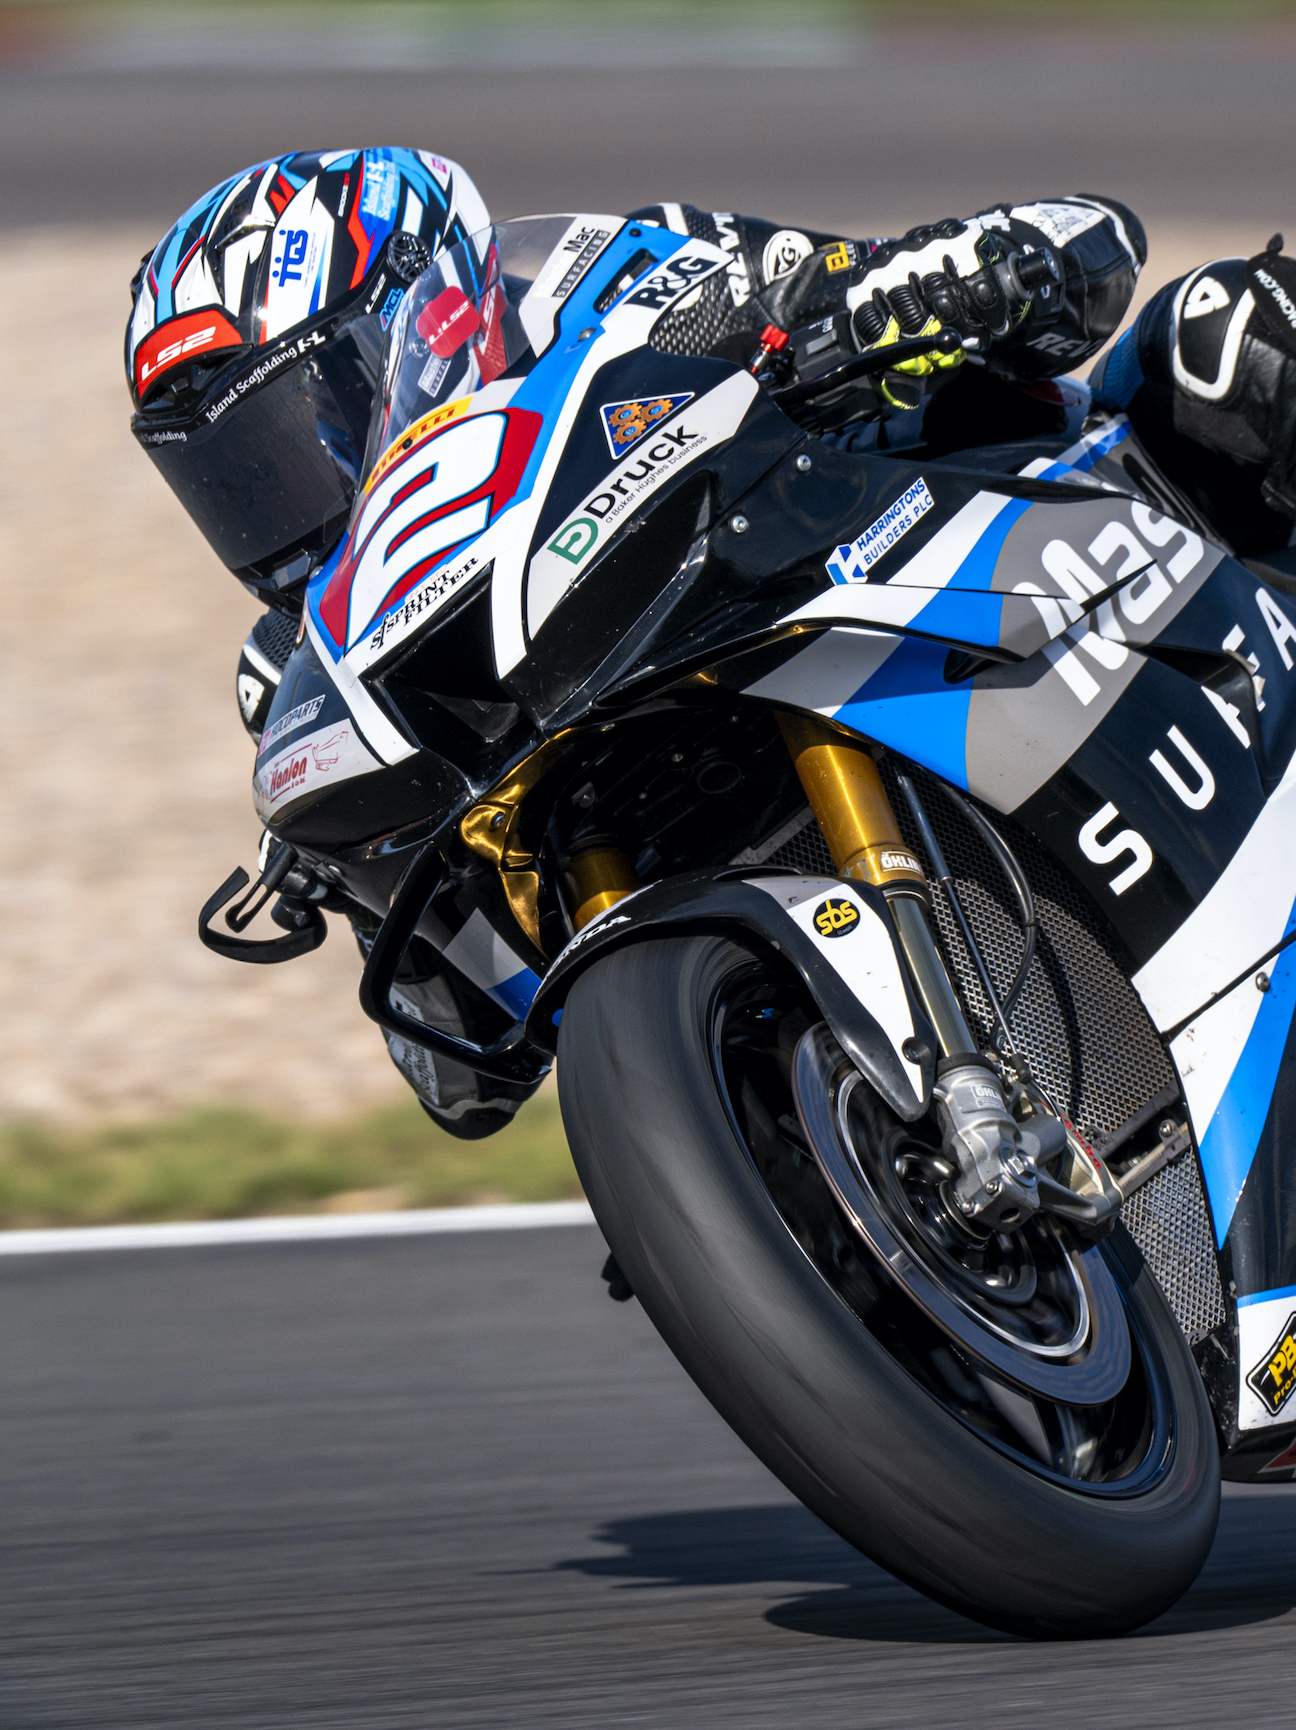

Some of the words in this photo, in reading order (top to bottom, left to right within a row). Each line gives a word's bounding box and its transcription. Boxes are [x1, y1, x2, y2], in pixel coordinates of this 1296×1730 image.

[273, 229, 309, 287] TGS
[555, 230, 610, 298] SURFACING
[624, 254, 719, 311] R&G
[364, 272, 387, 314] LS2
[141, 326, 217, 381] LS2
[205, 390, 238, 423] Island
[236, 346, 297, 394] Scaffolding
[583, 424, 700, 520] Druck
[605, 514, 613, 524] a
[612, 491, 637, 521] Baker
[634, 464, 670, 497] Hughes
[668, 434, 708, 469] business
[856, 479, 926, 552] HARRINGTONS
[863, 514, 913, 566] BUILDERS
[914, 494, 934, 518] PLC
[385, 569, 451, 635] SPRINT
[403, 557, 479, 628] FILTER
[815, 899, 858, 937] sbs
